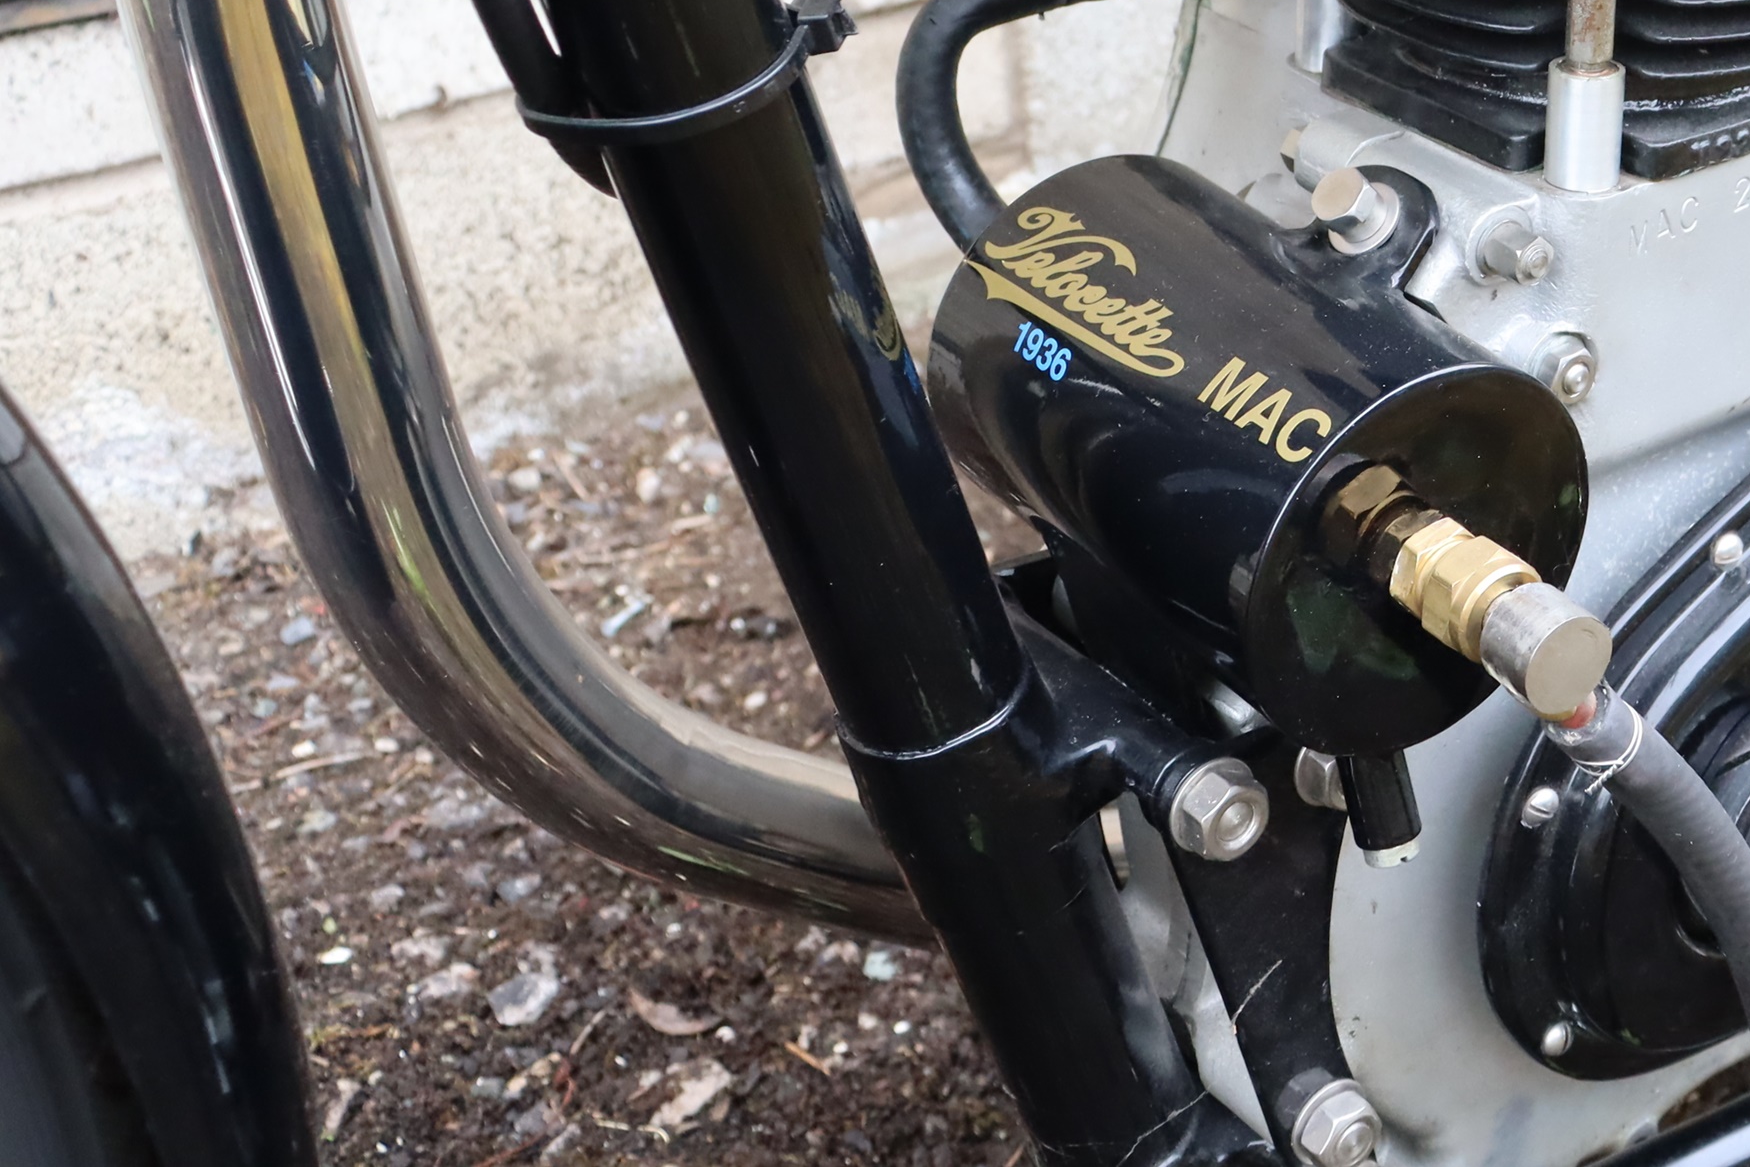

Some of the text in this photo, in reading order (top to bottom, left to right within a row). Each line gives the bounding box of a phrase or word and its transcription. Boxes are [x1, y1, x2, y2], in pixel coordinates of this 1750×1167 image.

[984, 206, 1184, 377] Velocette
[1012, 320, 1073, 382] 1936
[1197, 356, 1332, 463] MAC
